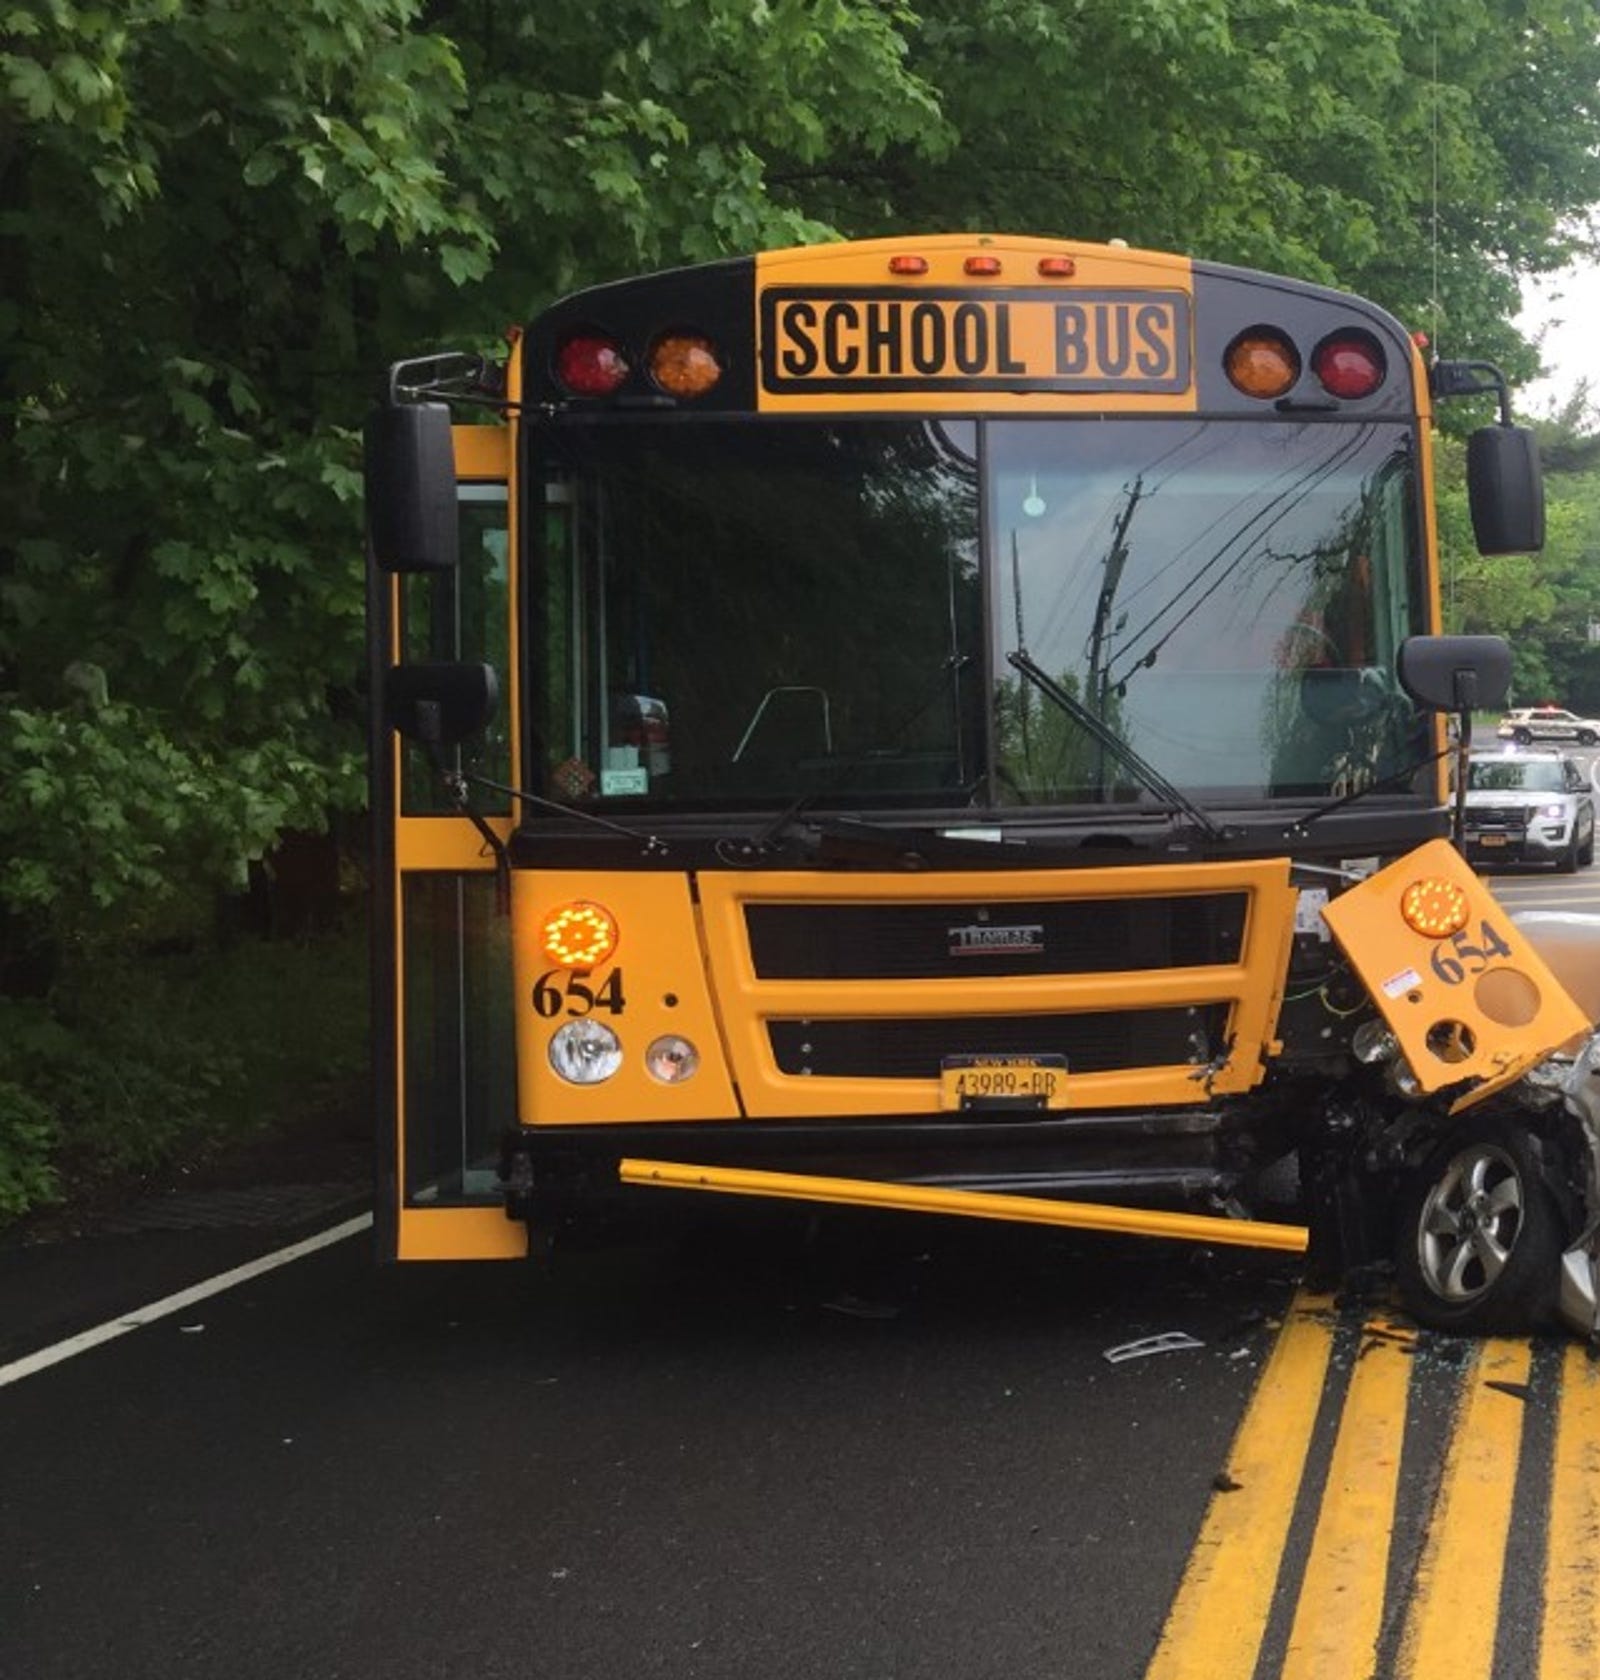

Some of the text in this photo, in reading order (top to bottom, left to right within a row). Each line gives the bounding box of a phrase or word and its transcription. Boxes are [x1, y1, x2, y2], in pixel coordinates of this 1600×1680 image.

[781, 301, 1170, 377] SCHOOL BUS
[1430, 920, 1512, 985] 654
[532, 967, 626, 1018] 654
